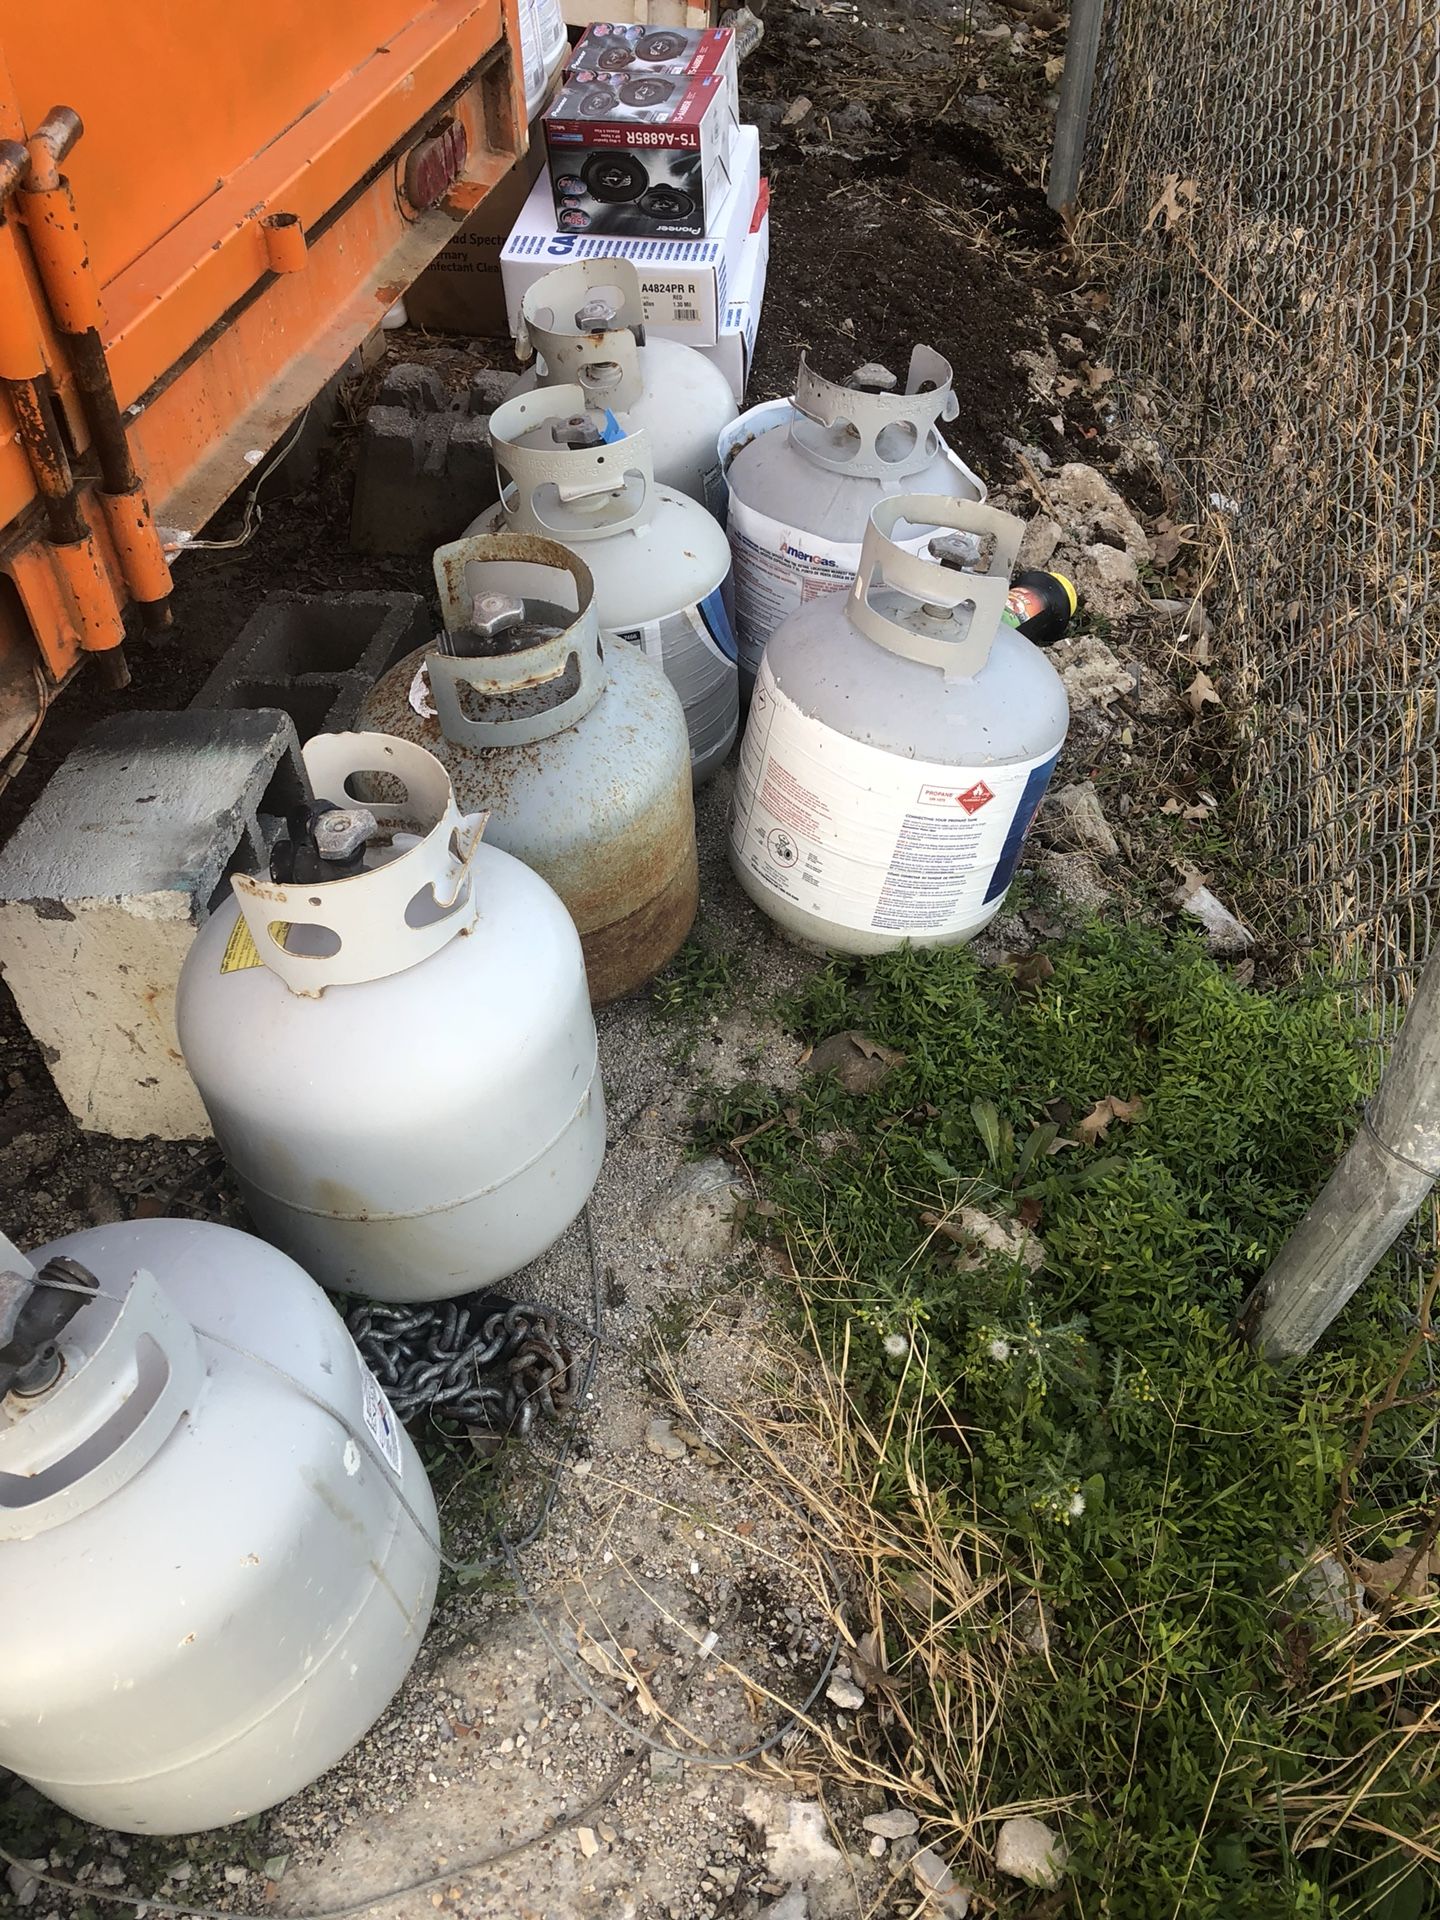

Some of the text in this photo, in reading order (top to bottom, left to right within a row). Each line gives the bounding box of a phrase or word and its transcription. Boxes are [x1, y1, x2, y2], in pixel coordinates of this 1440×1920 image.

[626, 131, 697, 146] TS-A6885R
[656, 226, 701, 235] Pioneer
[641, 283, 696, 294] A4824PR R
[779, 542, 836, 568] AmeriGas
[925, 790, 954, 798] PROPANE
